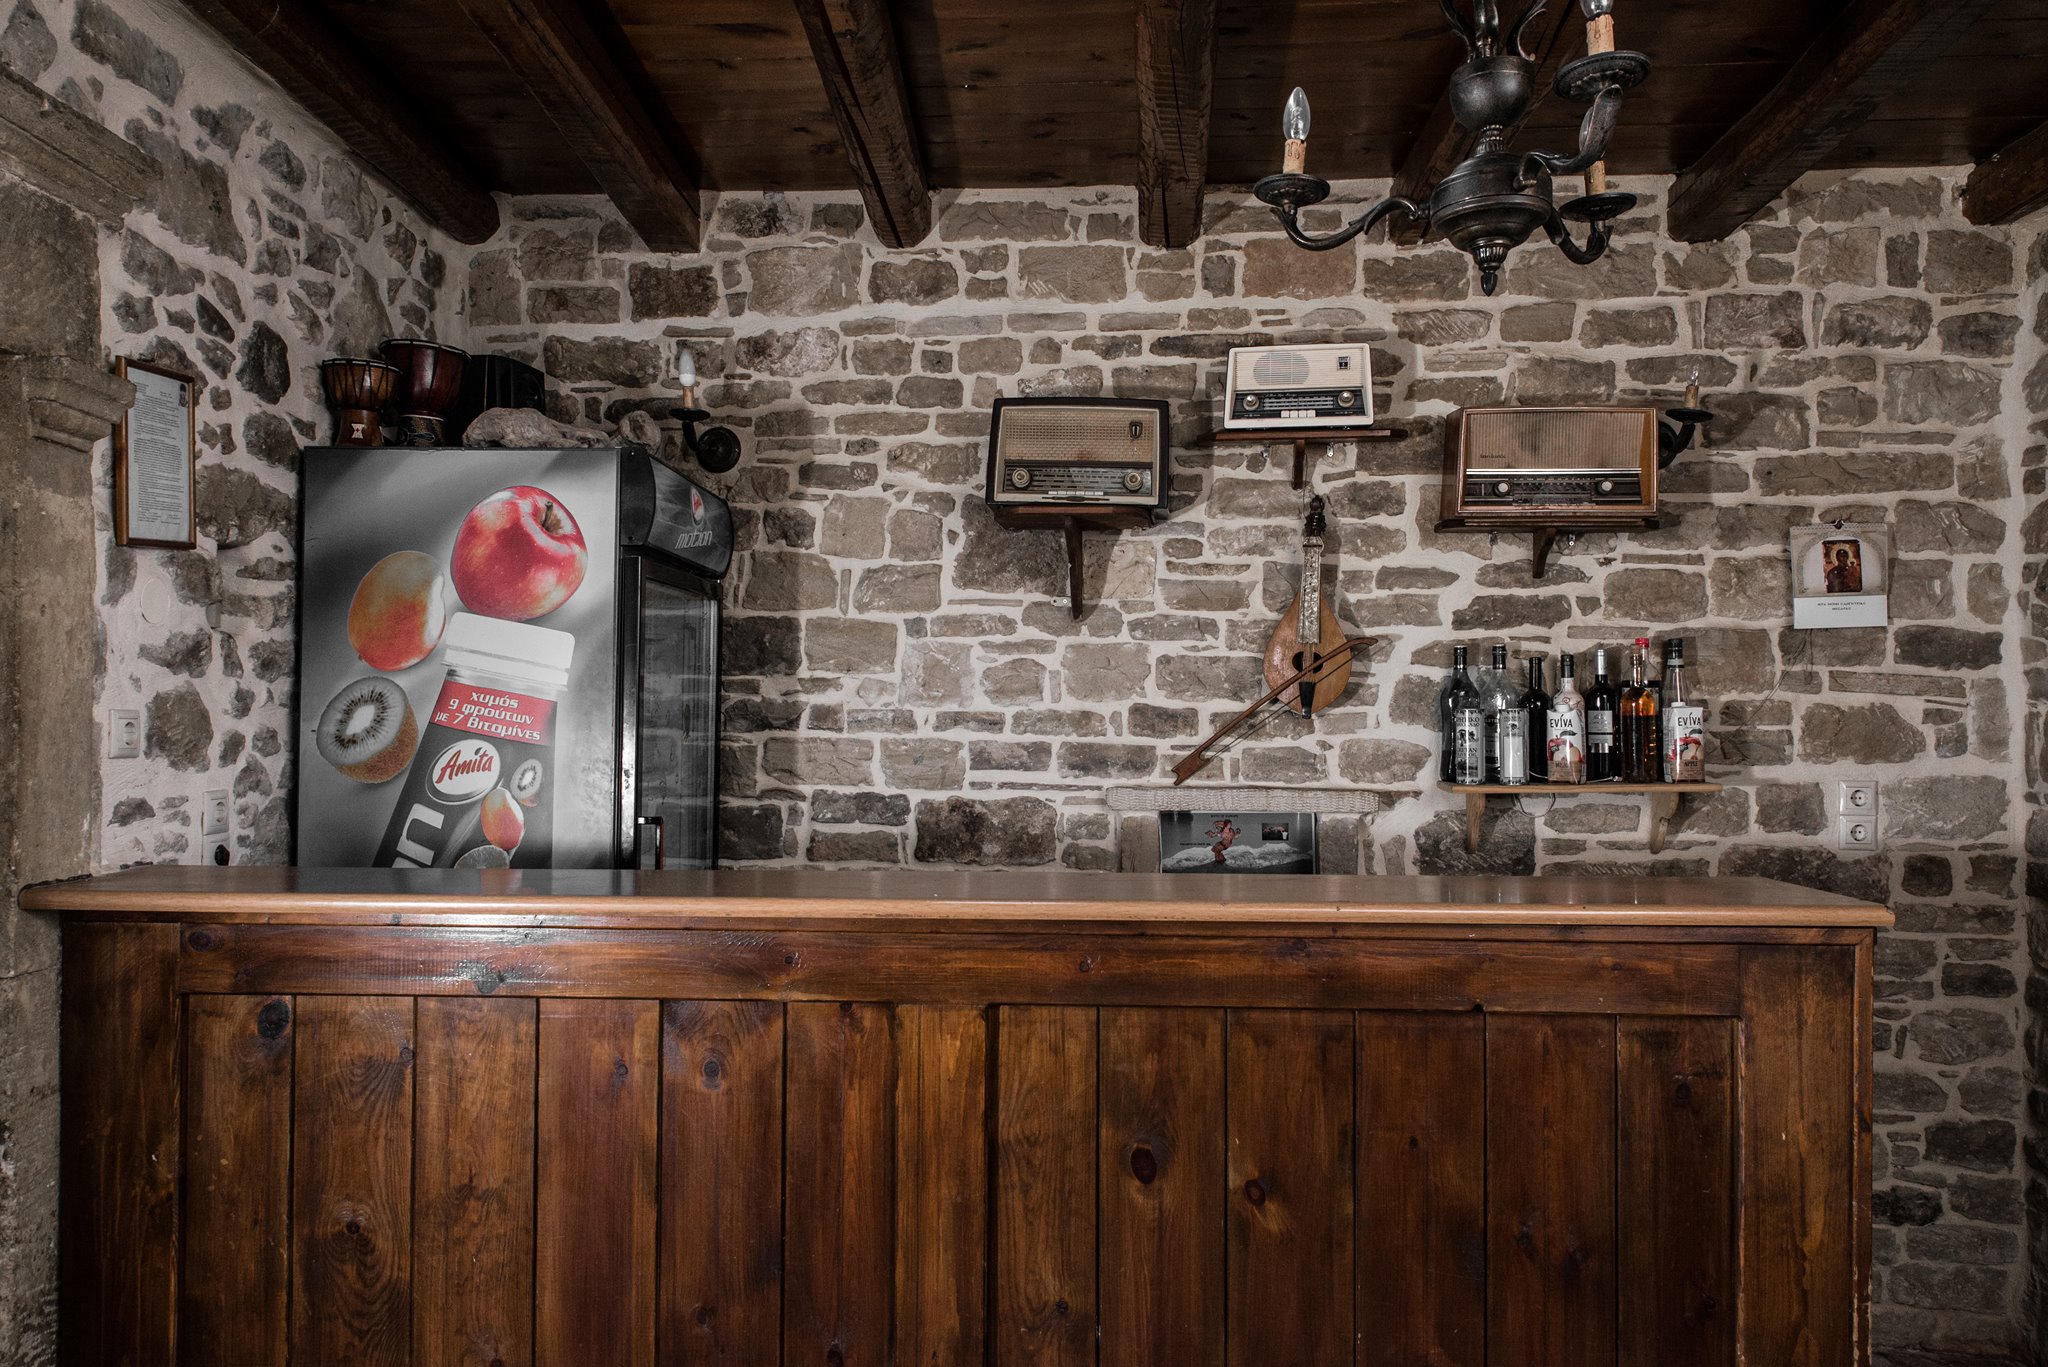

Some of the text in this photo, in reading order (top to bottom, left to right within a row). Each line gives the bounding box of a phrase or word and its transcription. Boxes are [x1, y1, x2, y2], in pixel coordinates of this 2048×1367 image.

[675, 528, 713, 549] motion
[470, 691, 519, 708] χυμός
[434, 711, 449, 722] με
[452, 713, 464, 724] 7
[448, 698, 534, 724] 9 φρούτων
[435, 748, 494, 784] Amita
